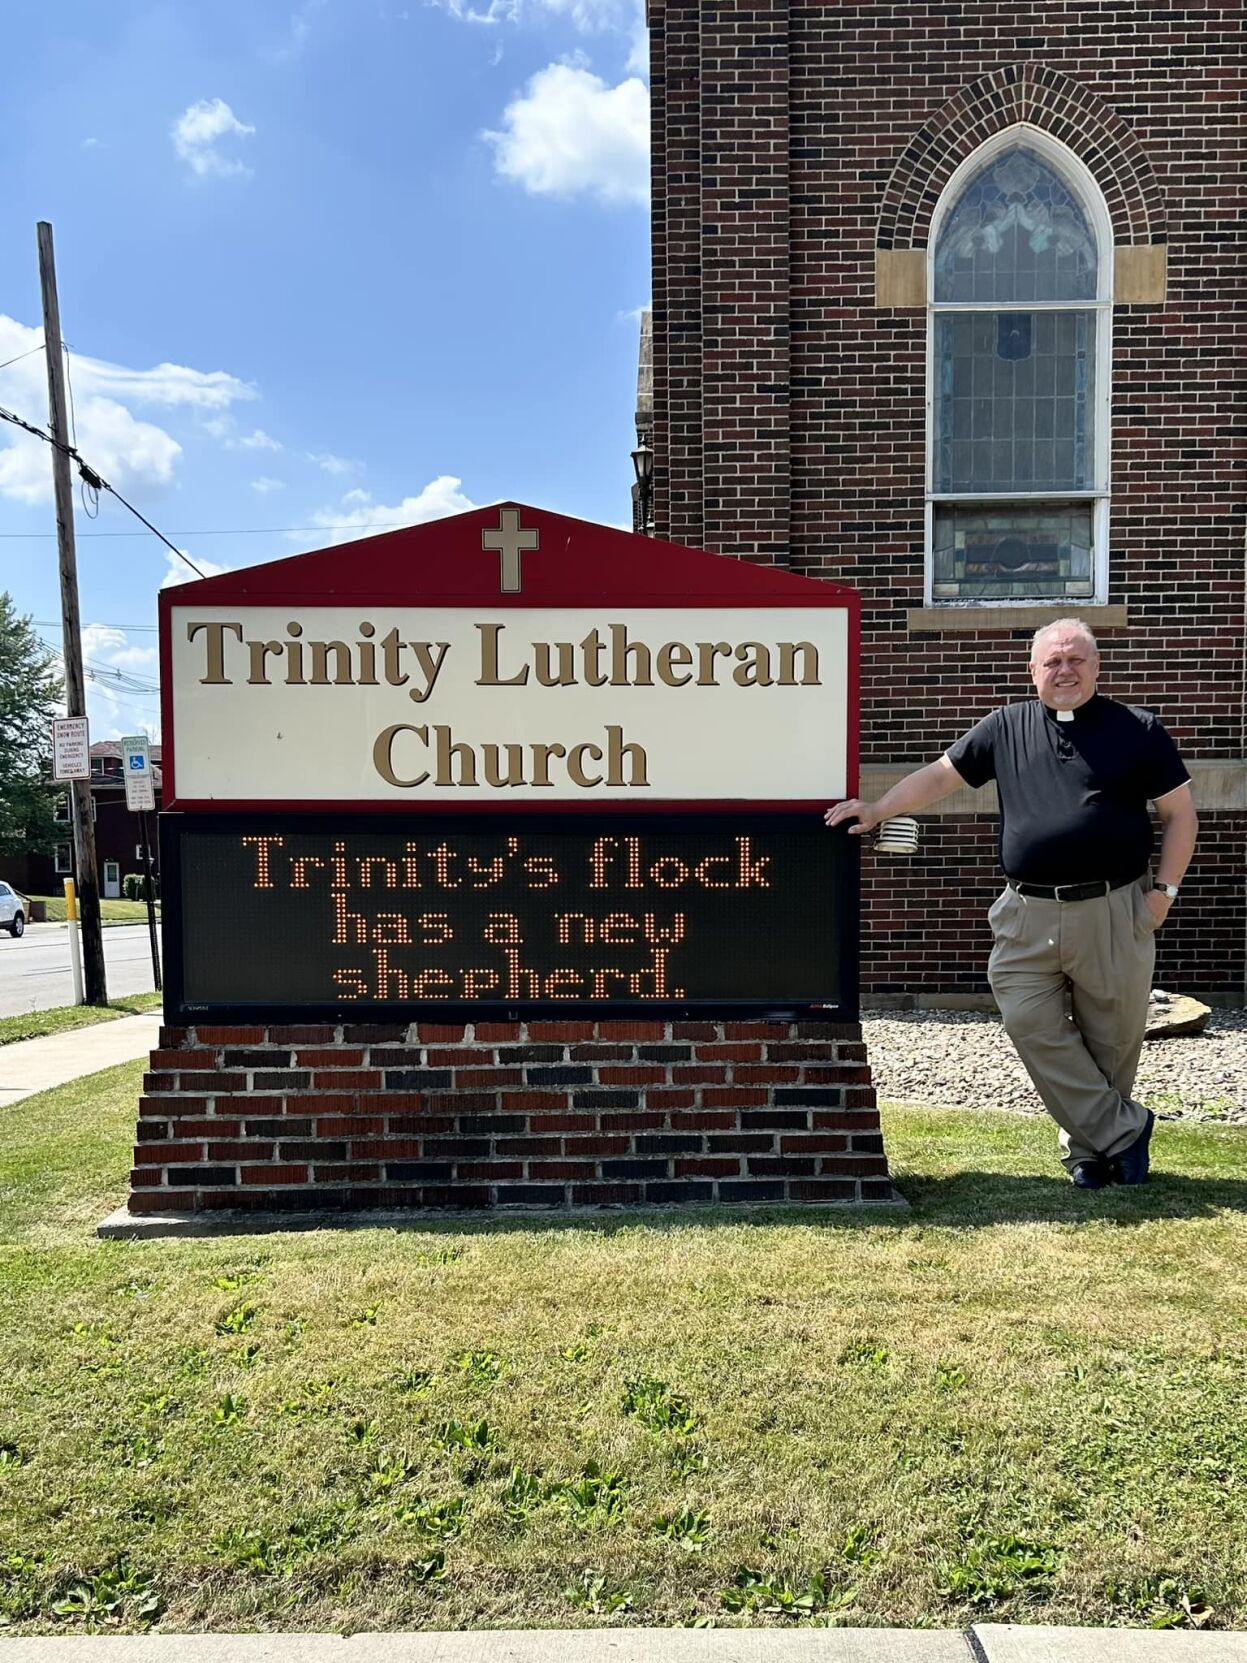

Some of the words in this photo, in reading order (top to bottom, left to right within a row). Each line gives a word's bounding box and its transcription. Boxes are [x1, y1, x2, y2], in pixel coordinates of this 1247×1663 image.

[187, 621, 451, 703] Trinity
[473, 622, 823, 688] Lutheran
[57, 722, 84, 731] EMERGENCY
[71, 730, 85, 738] ROUTE
[373, 723, 652, 788] Church
[242, 836, 558, 888] Trinity's
[589, 836, 770, 888] flock
[330, 893, 453, 944] has
[484, 913, 524, 944] a
[554, 913, 685, 944] new
[332, 948, 685, 999] shepherd.
